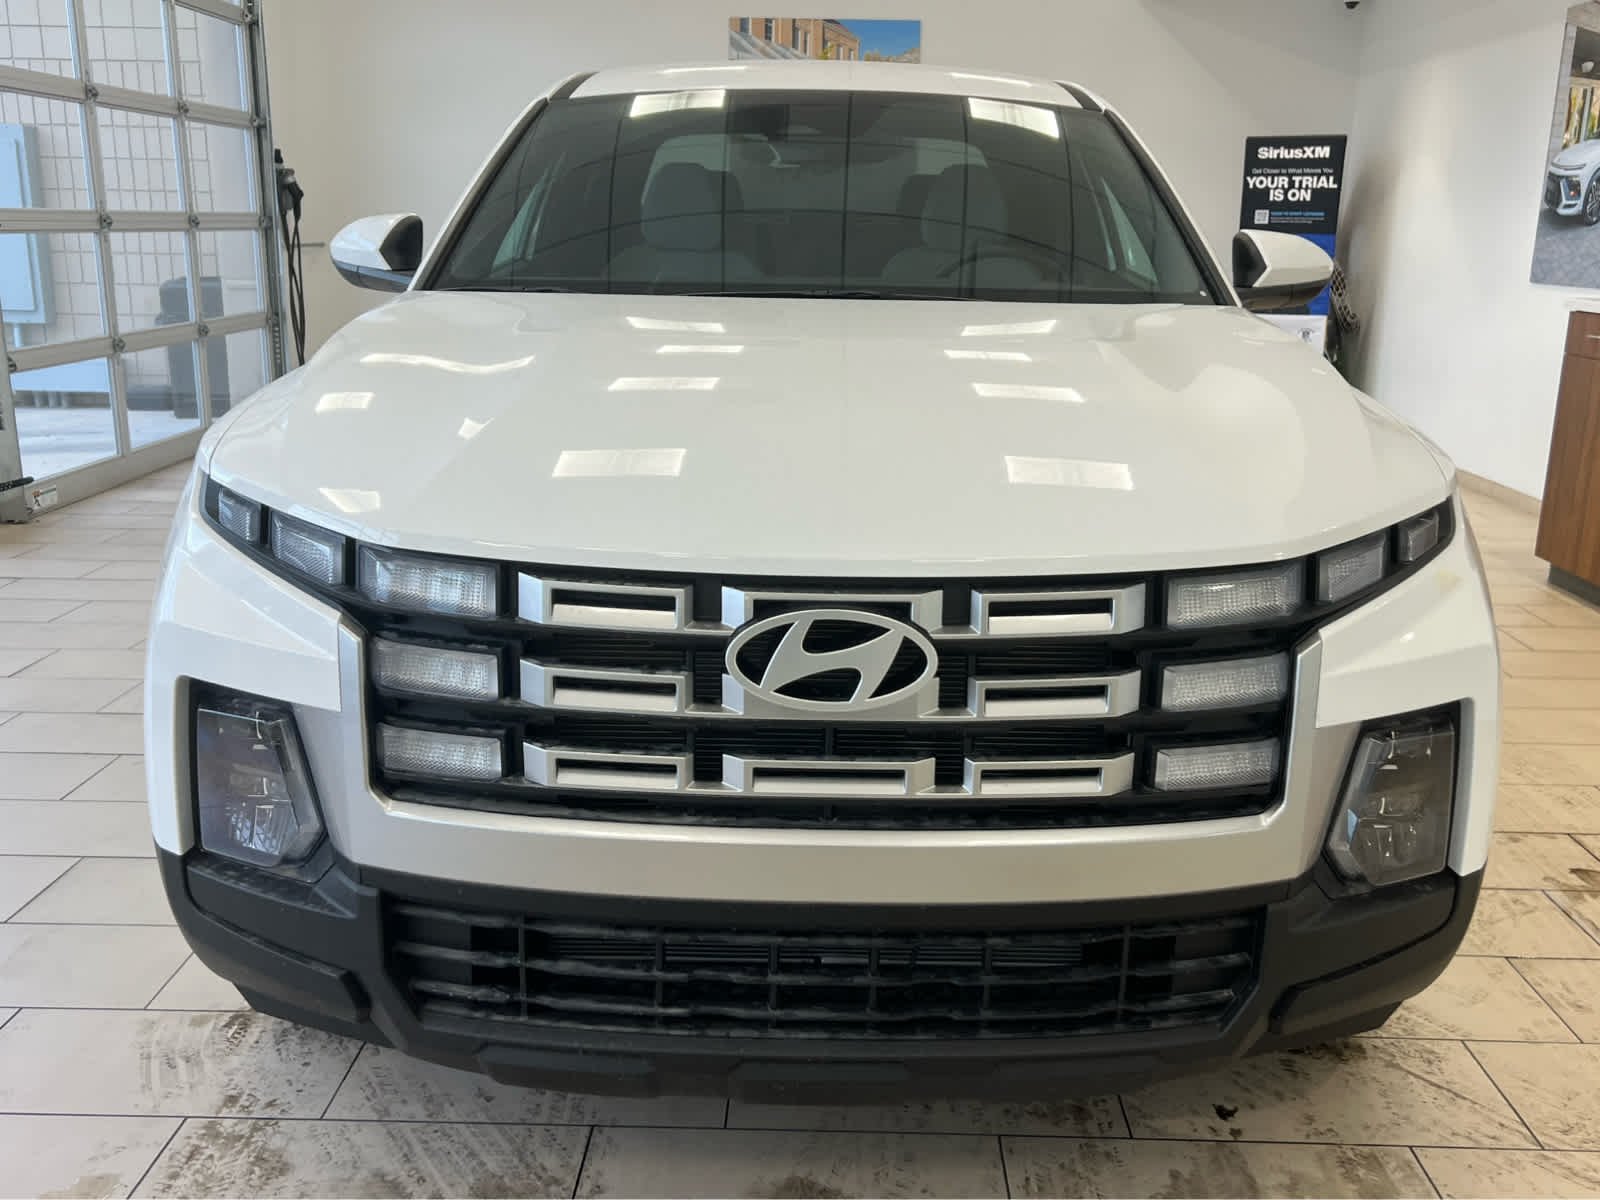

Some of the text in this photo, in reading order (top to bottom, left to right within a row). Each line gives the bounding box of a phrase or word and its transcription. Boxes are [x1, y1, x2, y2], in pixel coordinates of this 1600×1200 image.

[1257, 146, 1330, 159] SiriusXM
[1247, 175, 1338, 189] YOUR TRIAL
[1269, 189, 1311, 202] IS ON
